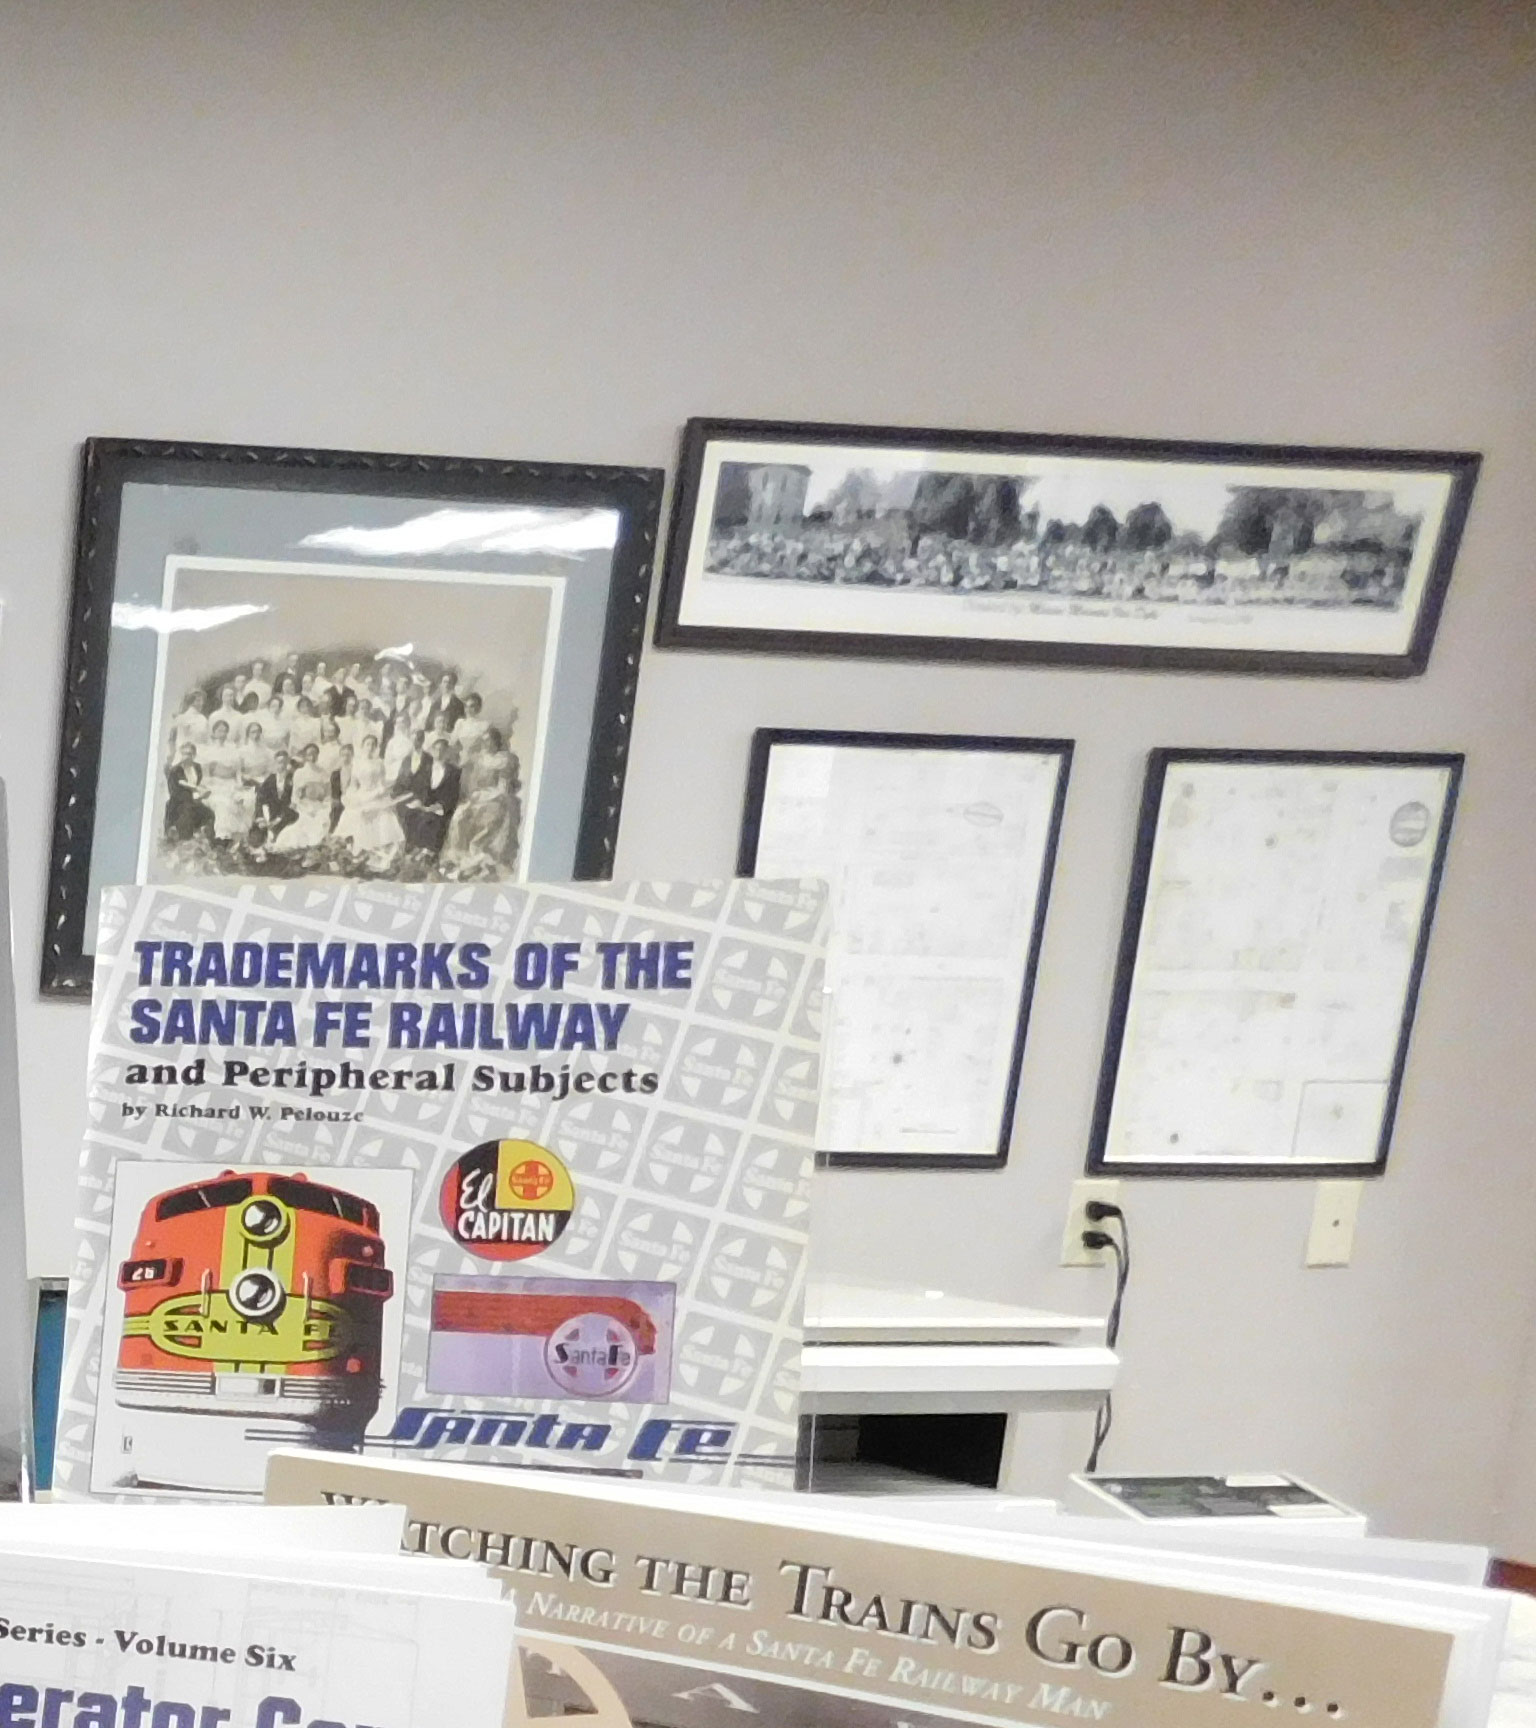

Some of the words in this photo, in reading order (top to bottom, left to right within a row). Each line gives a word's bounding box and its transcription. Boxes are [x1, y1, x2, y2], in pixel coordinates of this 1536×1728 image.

[133, 941, 492, 990] TRADEMARKS
[514, 942, 581, 990] OF
[597, 941, 694, 990] THE
[129, 998, 297, 1048] SANTA
[313, 1001, 373, 1049] FE
[388, 1001, 631, 1051] RAILWAY
[125, 1059, 206, 1086] and
[222, 1060, 455, 1097] Peripheral
[471, 1064, 659, 1101] Subjects
[121, 1102, 147, 1120] by
[155, 1103, 241, 1122] Richard
[249, 1106, 272, 1121] W.
[280, 1107, 364, 1124] Pelouze
[460, 1168, 494, 1211] El
[458, 1212, 557, 1243] CAPITAN
[163, 1319, 279, 1337] SANTA
[635, 1554, 754, 1610] THE
[779, 1559, 1002, 1654] TRAINS
[1025, 1605, 1136, 1679] GO
[114, 1629, 237, 1664] Volume
[244, 1644, 296, 1672] Six
[525, 1590, 671, 1639] NARRATIVE
[677, 1619, 714, 1647] OF
[746, 1628, 836, 1671] SANTA
[844, 1647, 880, 1680] FE
[887, 1655, 1024, 1706] RAILWAY
[1029, 1682, 1113, 1722] MAN
